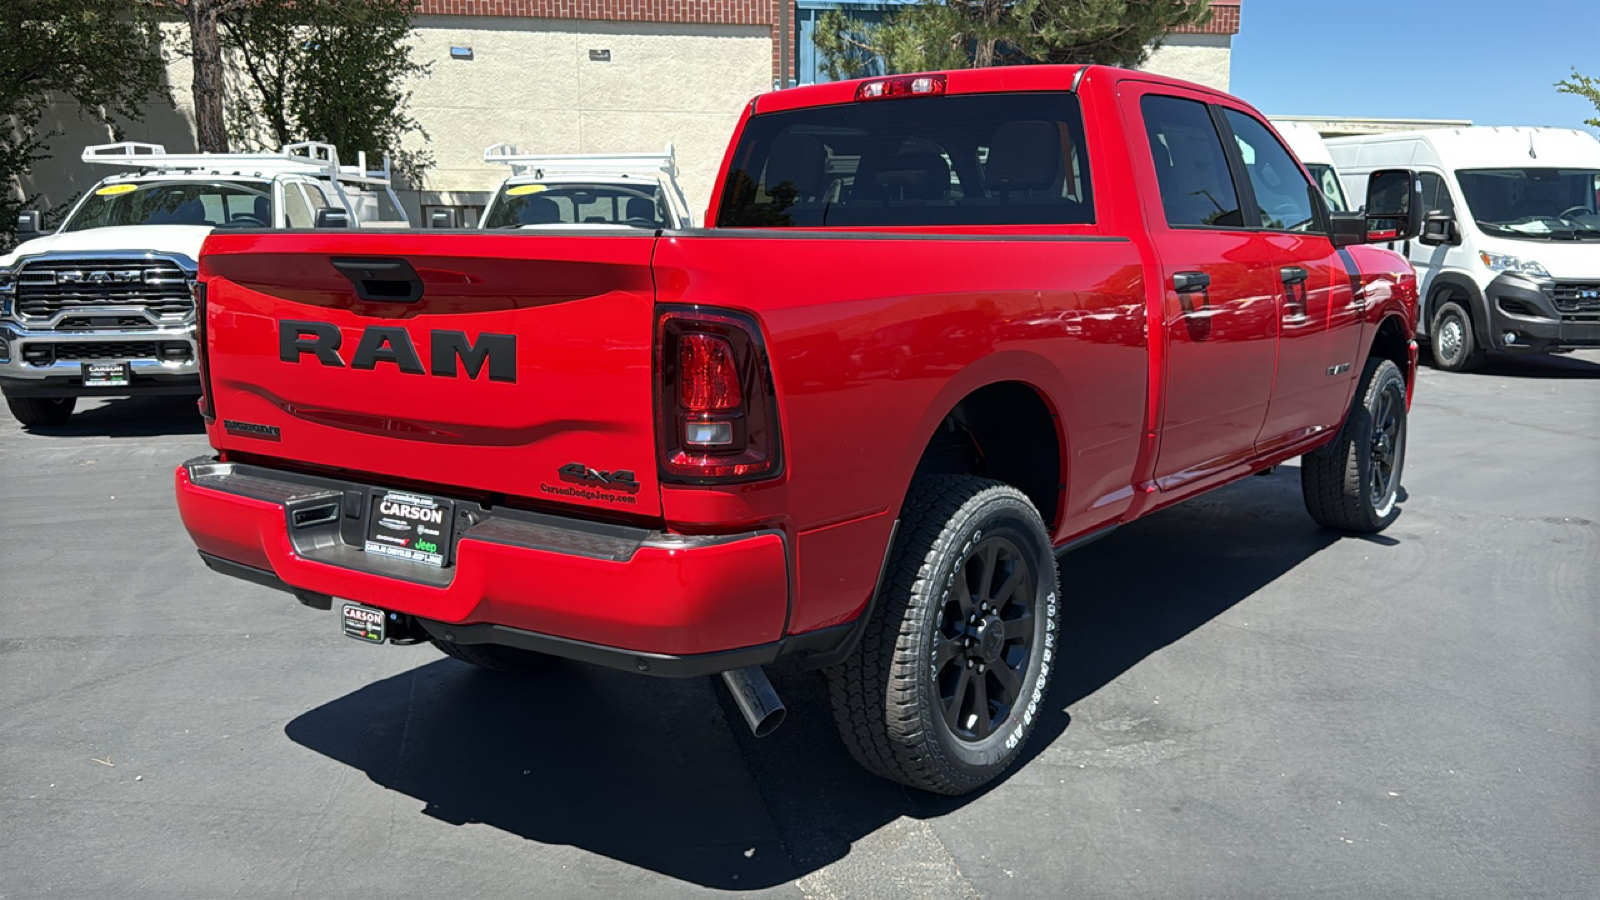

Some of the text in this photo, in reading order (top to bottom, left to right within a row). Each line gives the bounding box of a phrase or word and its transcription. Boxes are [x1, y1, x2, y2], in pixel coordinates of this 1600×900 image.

[279, 319, 517, 384] RAM
[540, 483, 636, 504] CarsonDodgeJeep.com
[380, 501, 443, 524] CARSON
[415, 538, 437, 553] Jeep
[345, 608, 381, 624] CARSON
[1023, 592, 1056, 726] TRANSFORCE
